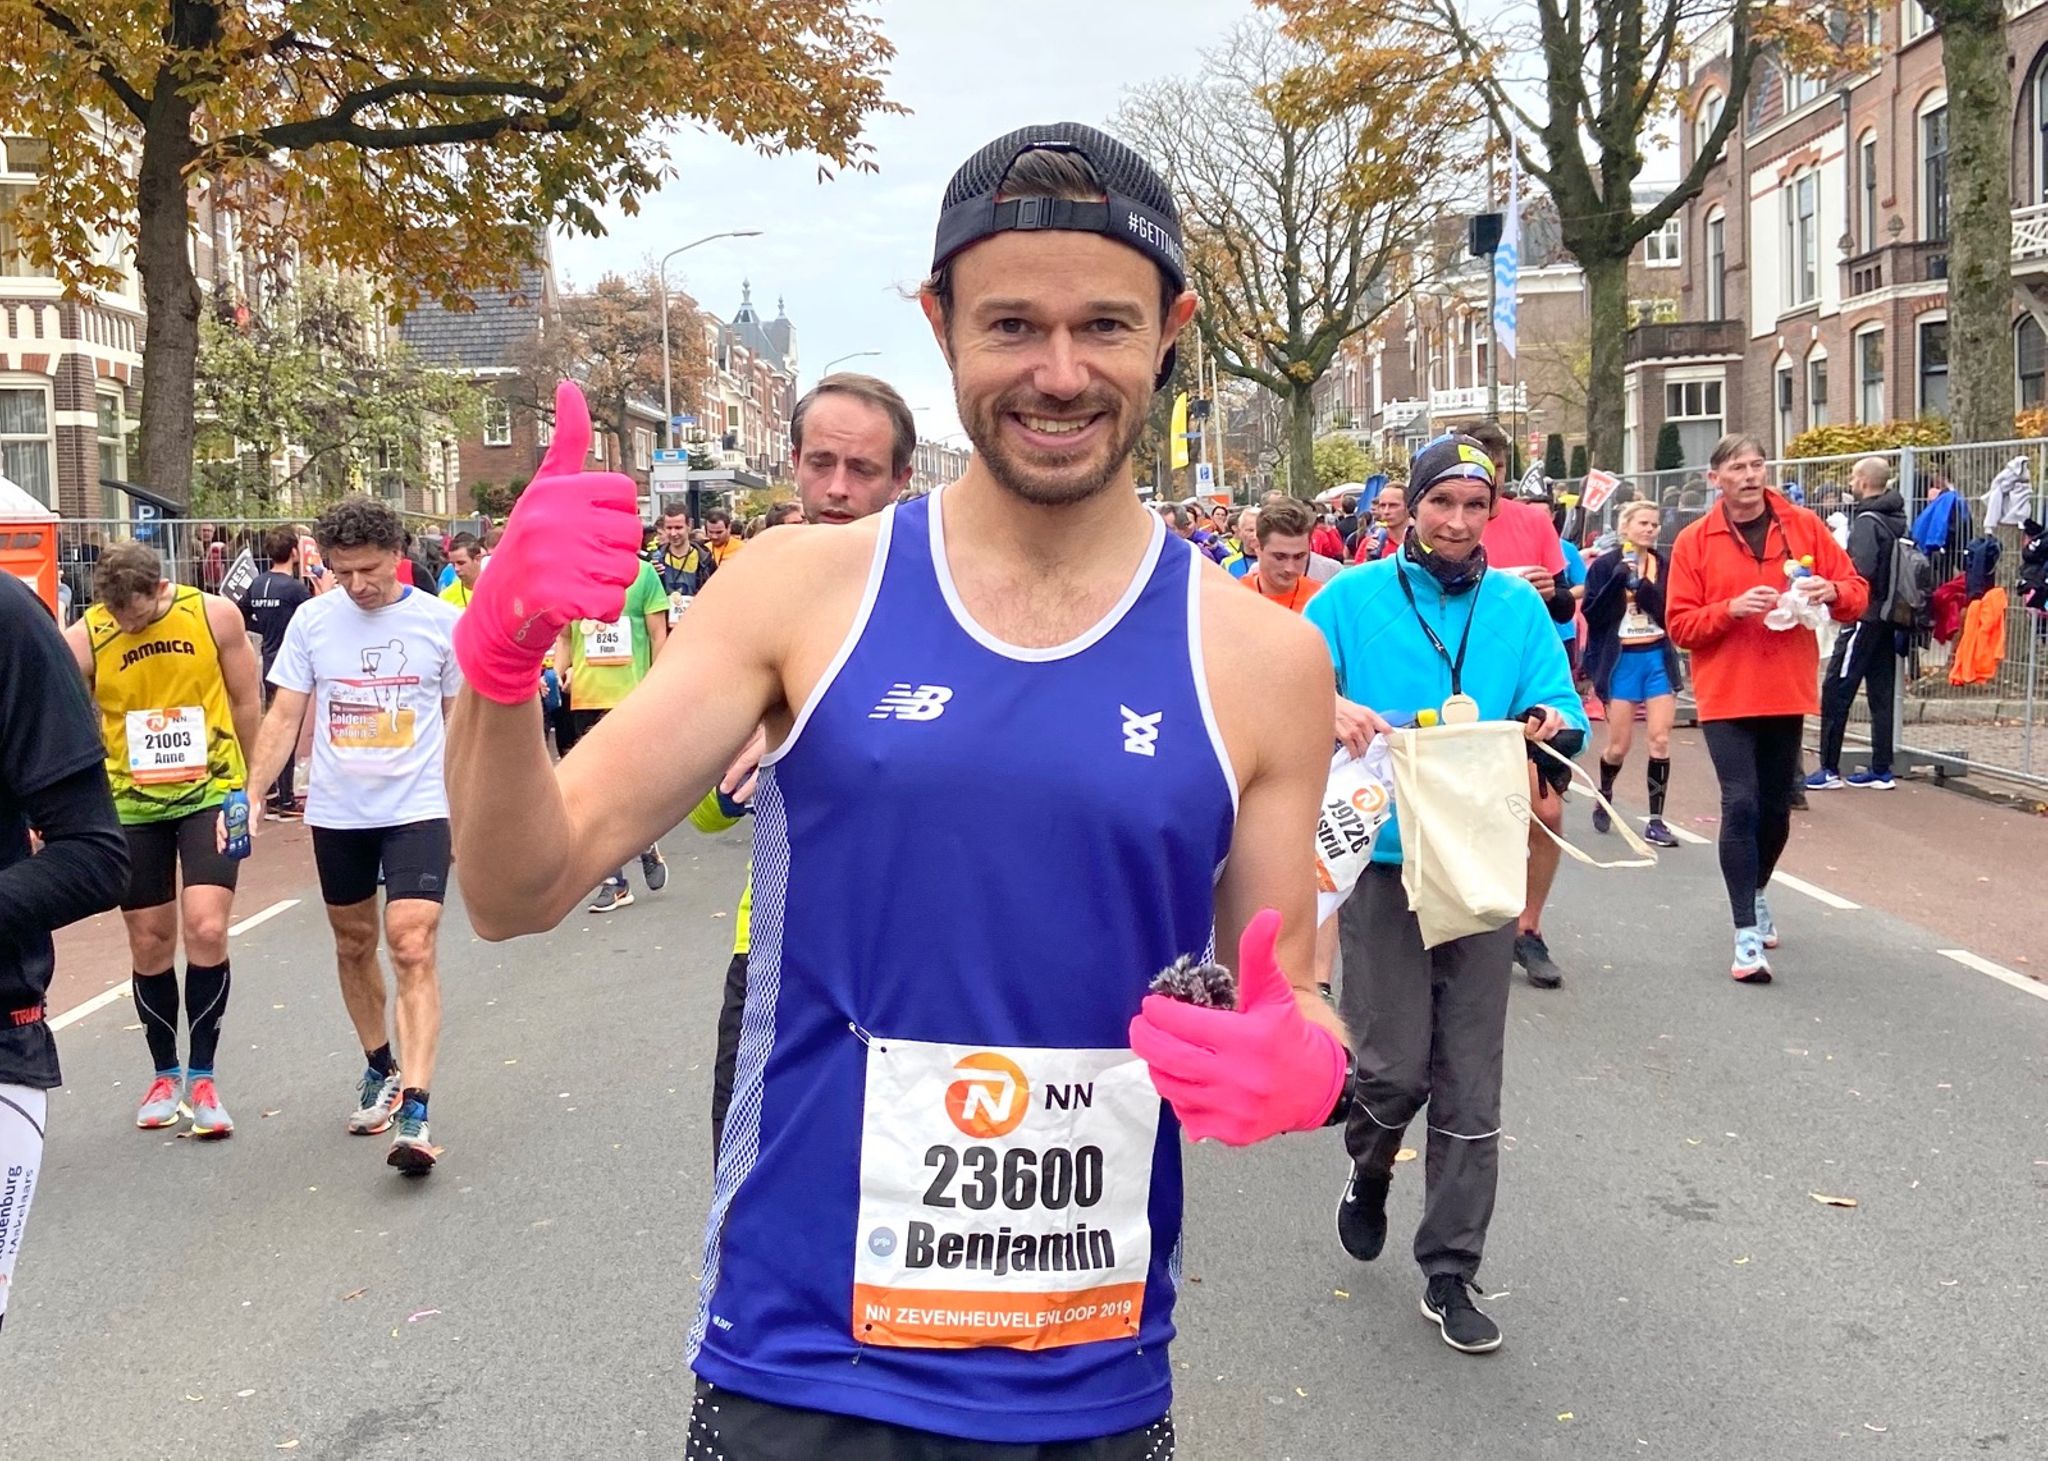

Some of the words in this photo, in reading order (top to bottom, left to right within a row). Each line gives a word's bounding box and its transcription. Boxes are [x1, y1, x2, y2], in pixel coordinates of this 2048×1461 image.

[139, 505, 155, 525] P
[227, 560, 252, 591] REST
[251, 599, 280, 607] CAPTAIN
[596, 632, 619, 644] 8245
[119, 639, 195, 671] JAMAICA
[331, 713, 367, 724] Golden
[145, 731, 191, 749] 21003
[154, 752, 185, 764] Anne
[1328, 798, 1370, 854] 19726
[1045, 1082, 1094, 1110] NN
[922, 1144, 1104, 1211] 23600
[905, 1220, 1115, 1276] Benjamin
[866, 1304, 890, 1322] NN
[896, 1304, 1098, 1328] ZEVENHEUVELENLOOP
[1100, 1300, 1132, 1317] 2019
